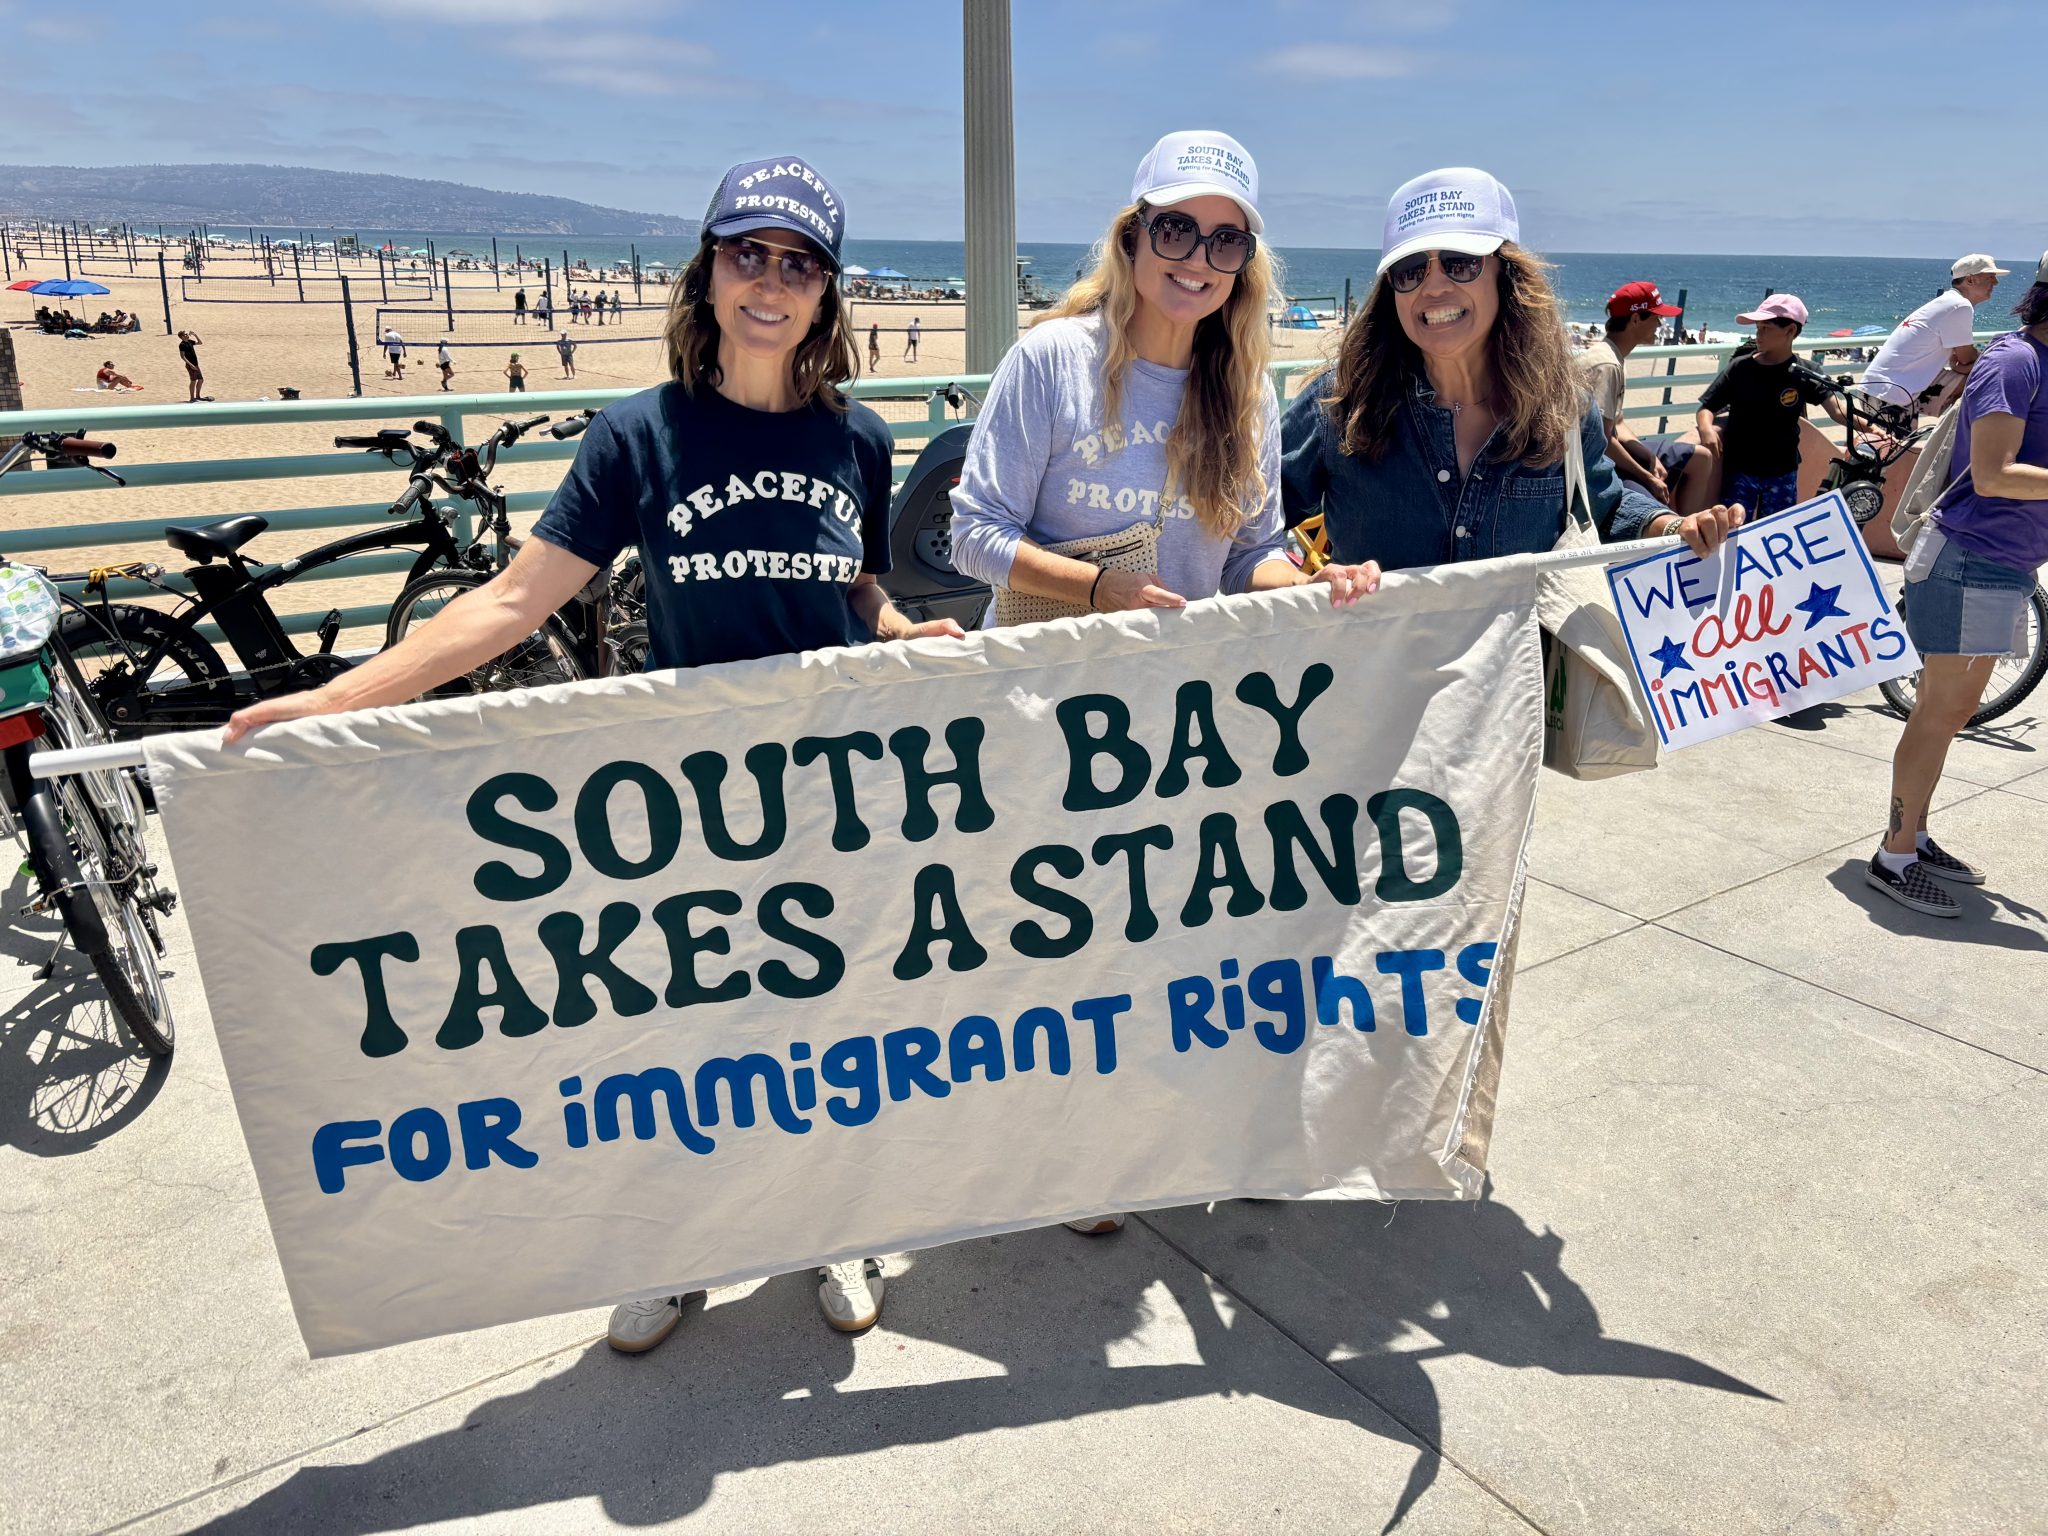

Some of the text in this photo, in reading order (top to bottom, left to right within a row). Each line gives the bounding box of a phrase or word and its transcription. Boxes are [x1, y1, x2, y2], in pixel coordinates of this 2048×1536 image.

[1177, 155, 1250, 185] TAKES A STAND
[1187, 145, 1244, 168] SOUTH BAY
[738, 163, 840, 223] PEACEFUL
[1397, 202, 1475, 225] TAKES A STAND
[1405, 190, 1463, 211] SOUTH BAY
[735, 195, 833, 246] PROTESTER
[1073, 420, 1171, 465] PEAC
[1066, 478, 1196, 520] PROTES
[1623, 511, 1846, 618] WE ARE
[1691, 583, 1793, 658] all
[466, 662, 1334, 902] SOUTH BAY
[310, 788, 1463, 1058] TAKES A STAND
[312, 1097, 539, 1194] FOR
